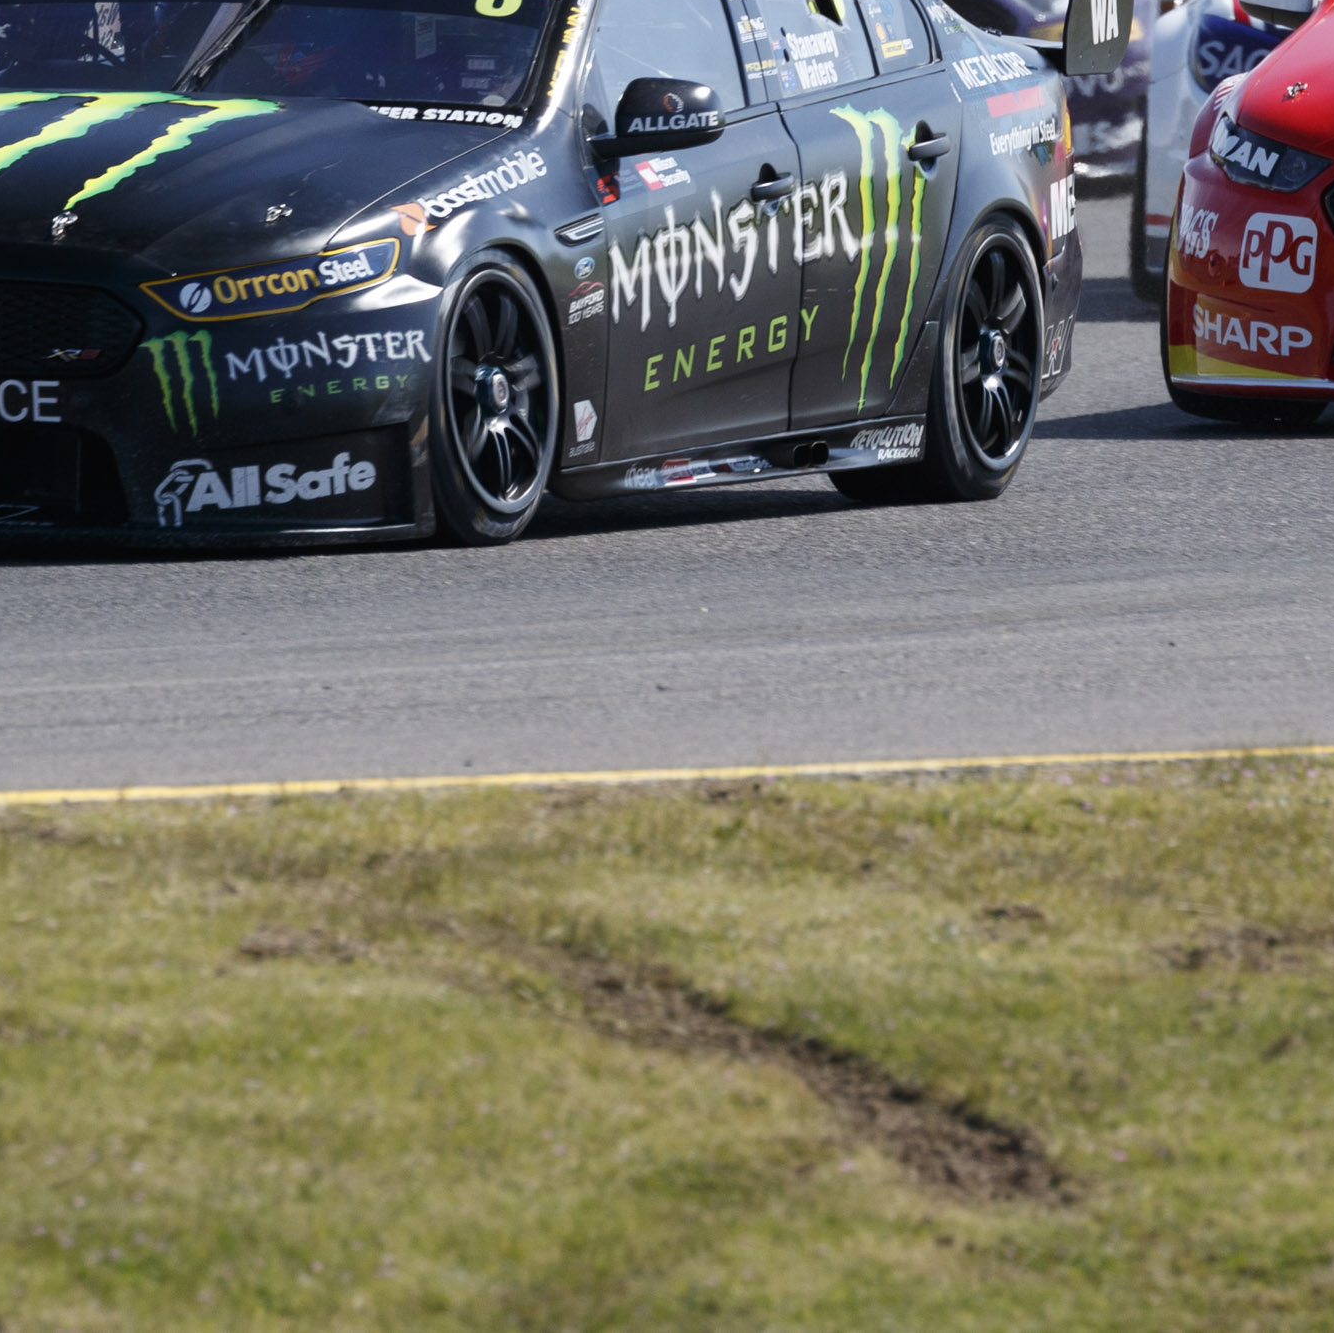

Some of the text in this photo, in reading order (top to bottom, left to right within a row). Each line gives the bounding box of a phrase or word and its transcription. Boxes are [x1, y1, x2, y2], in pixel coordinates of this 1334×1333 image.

[421, 107, 524, 129] STATION
[627, 111, 719, 134] ALLGATE
[212, 251, 375, 306] Orrcon Steel
[1241, 219, 1314, 283] PPG
[225, 327, 433, 383] MONSTER
[643, 305, 820, 393] ENERGY
[1192, 302, 1313, 357] SHARP
[269, 372, 409, 404] ENERGY
[850, 422, 925, 452] REVOLUTION
